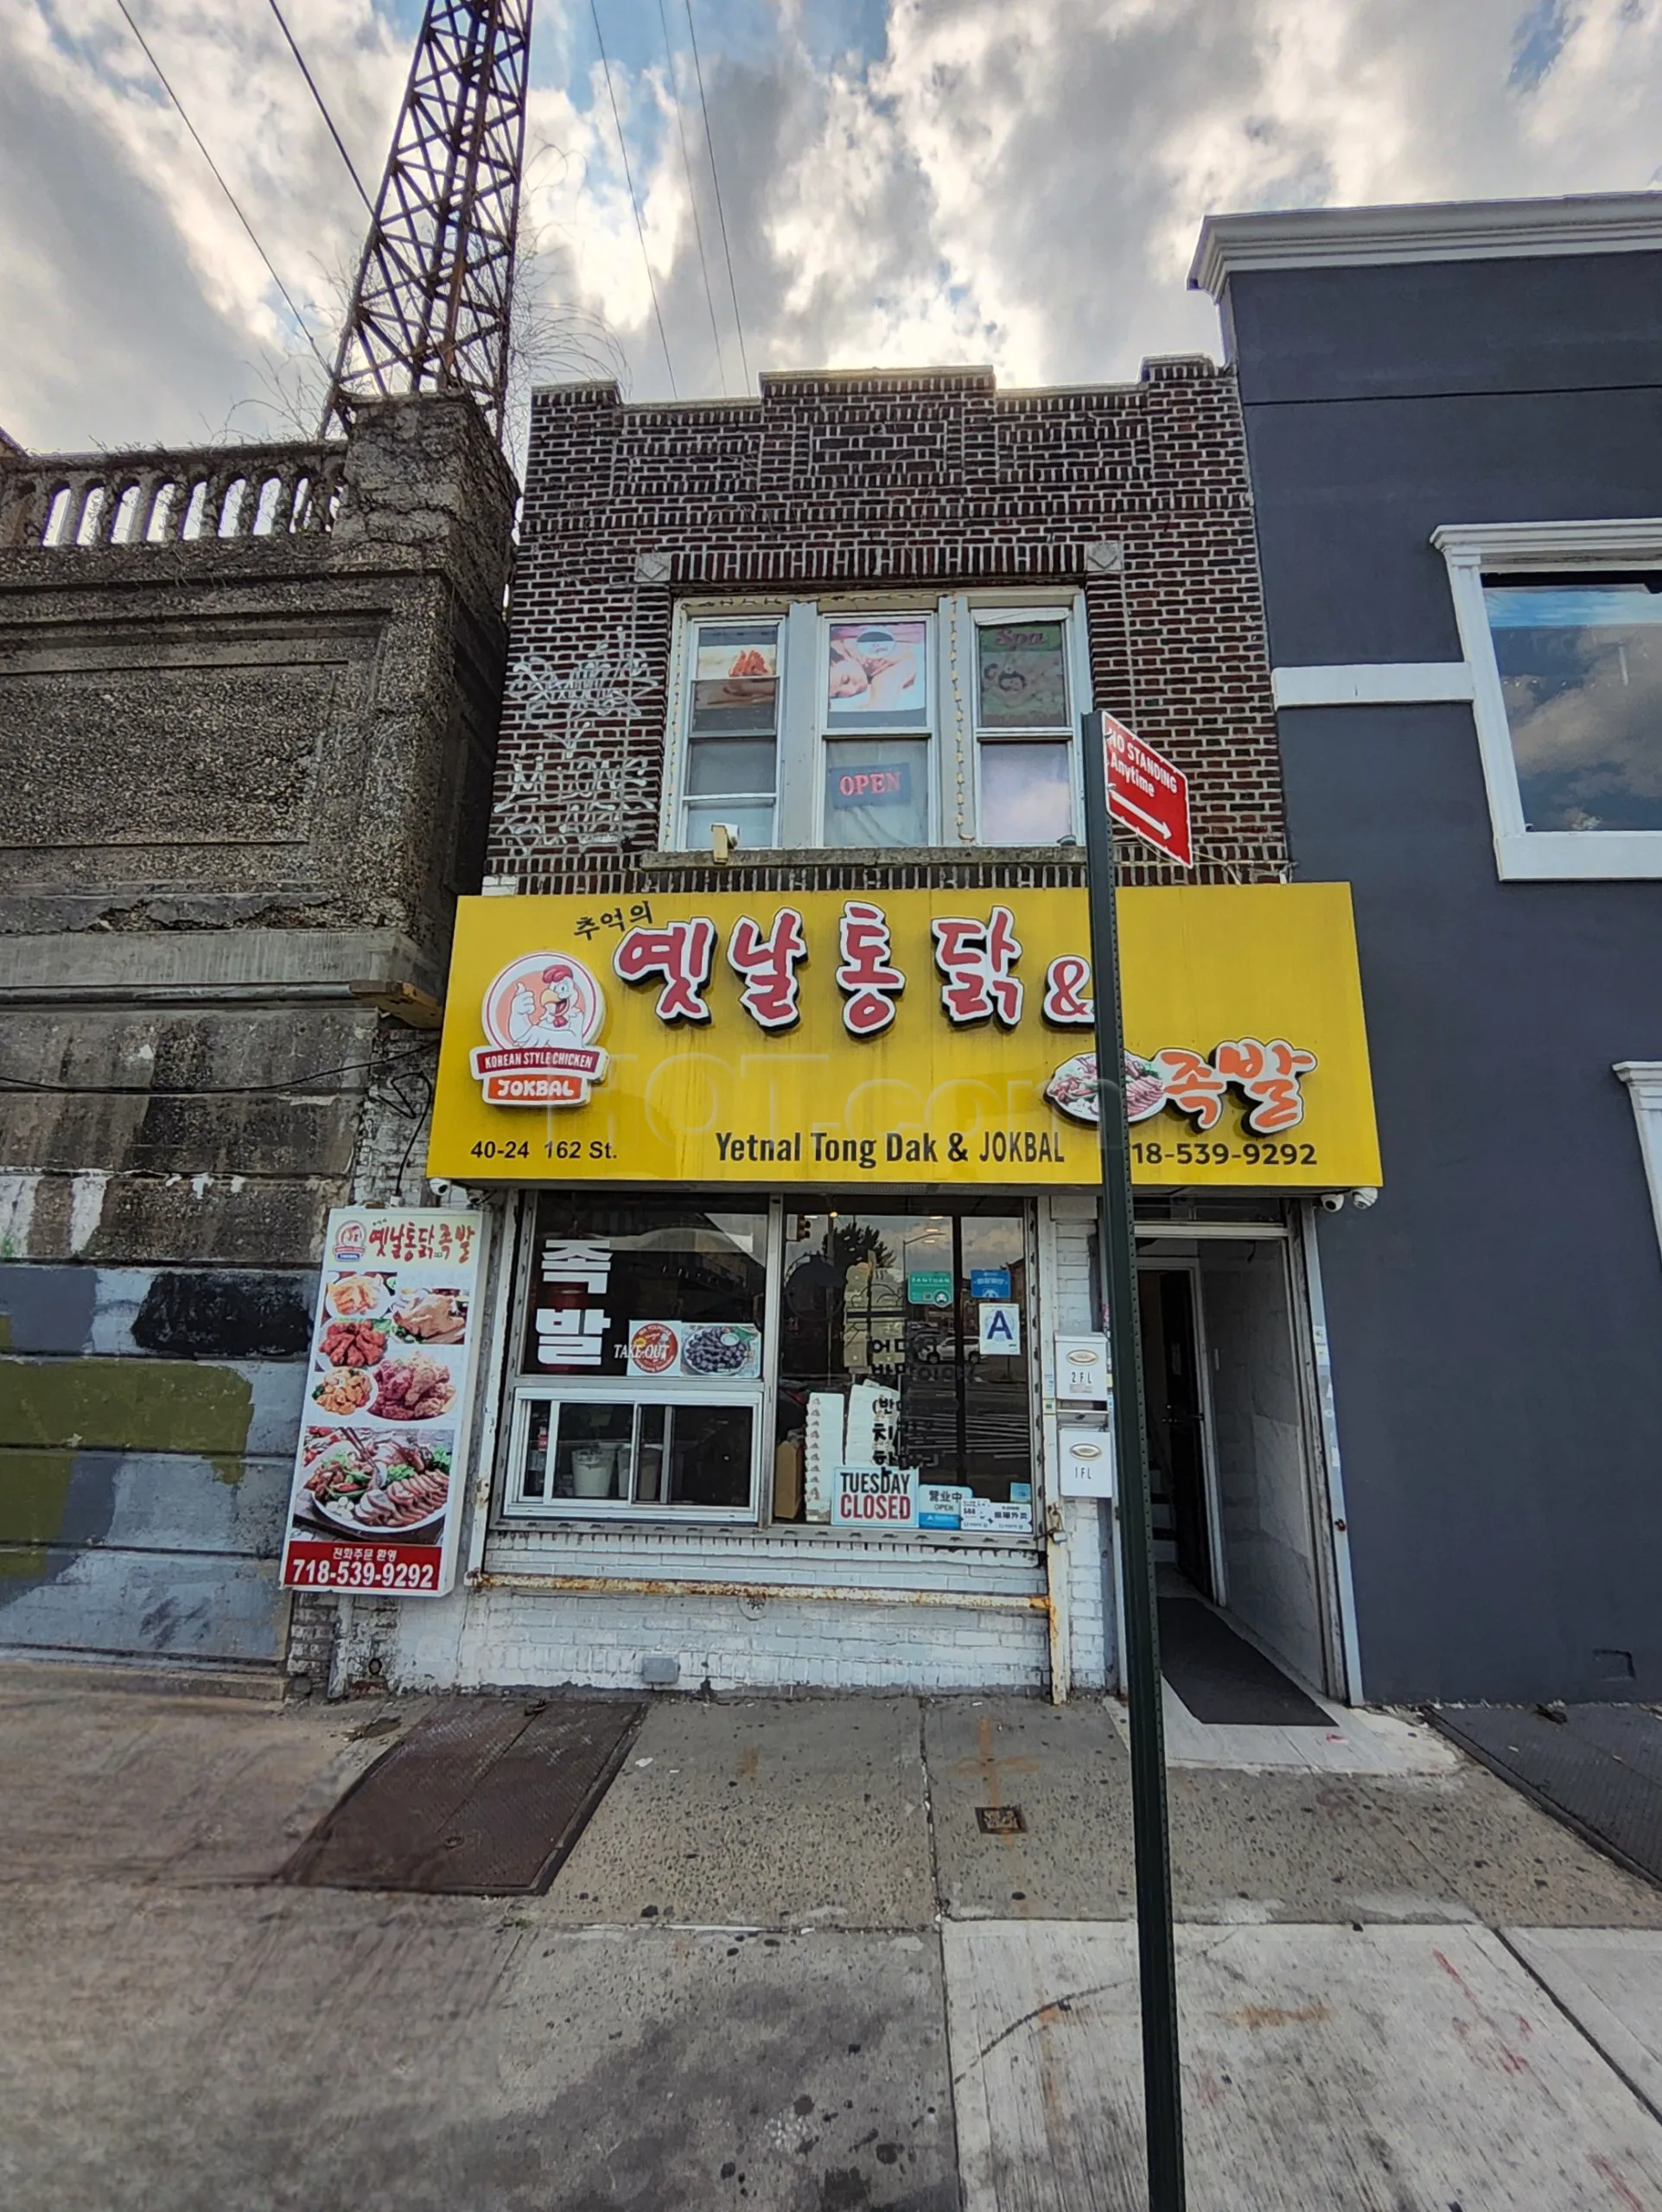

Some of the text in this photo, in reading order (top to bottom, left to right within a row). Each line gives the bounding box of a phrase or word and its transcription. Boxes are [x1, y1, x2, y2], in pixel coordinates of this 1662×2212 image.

[1105, 728, 1178, 794] NO STANDING
[1110, 752, 1156, 798] Anytime
[838, 771, 901, 797] OPEN
[573, 901, 653, 940] 추억의
[1044, 955, 1094, 1028] &
[485, 1052, 593, 1070] KOREAN STYLE CHICKEN
[497, 1079, 575, 1096] JOKBAL
[1161, 1039, 1317, 1133] 족발
[470, 1141, 617, 1159] 40-24 162 St.
[716, 1131, 1065, 1169] Yetnal Tong Dak & JOKBAL
[1130, 1142, 1318, 1166] 18-539-9292
[535, 1239, 614, 1365] 족발
[986, 1309, 1014, 1340] A
[840, 1472, 910, 1494] TUESDAY
[840, 1494, 911, 1521] CLOSED
[292, 1559, 434, 1588] 718-539-9292
